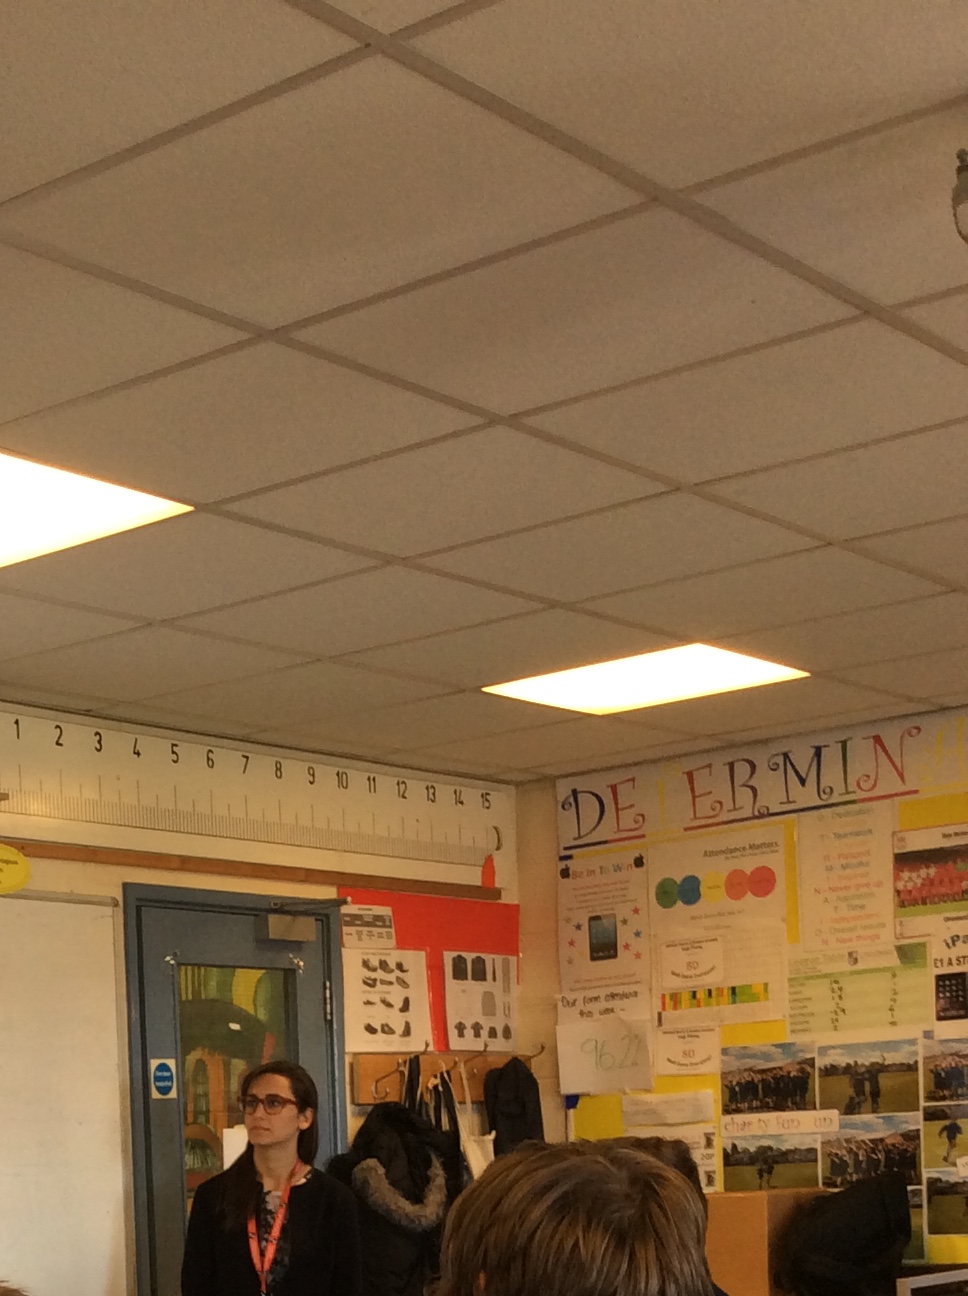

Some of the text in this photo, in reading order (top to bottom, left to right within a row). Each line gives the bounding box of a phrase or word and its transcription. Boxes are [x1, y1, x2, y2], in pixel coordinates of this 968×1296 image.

[13, 718, 21, 739] 1
[54, 724, 64, 747] 2
[94, 731, 103, 752] 3
[132, 737, 141, 758] 4
[170, 743, 180, 763] 5
[206, 749, 215, 769] 6
[241, 754, 250, 774] 7
[274, 760, 283, 779] 8
[307, 766, 316, 785] 9
[335, 770, 349, 790] 10
[366, 775, 377, 794] 11
[395, 779, 408, 800] 12
[425, 784, 437, 803] 13
[453, 788, 465, 806] 14
[481, 792, 491, 810] 15
